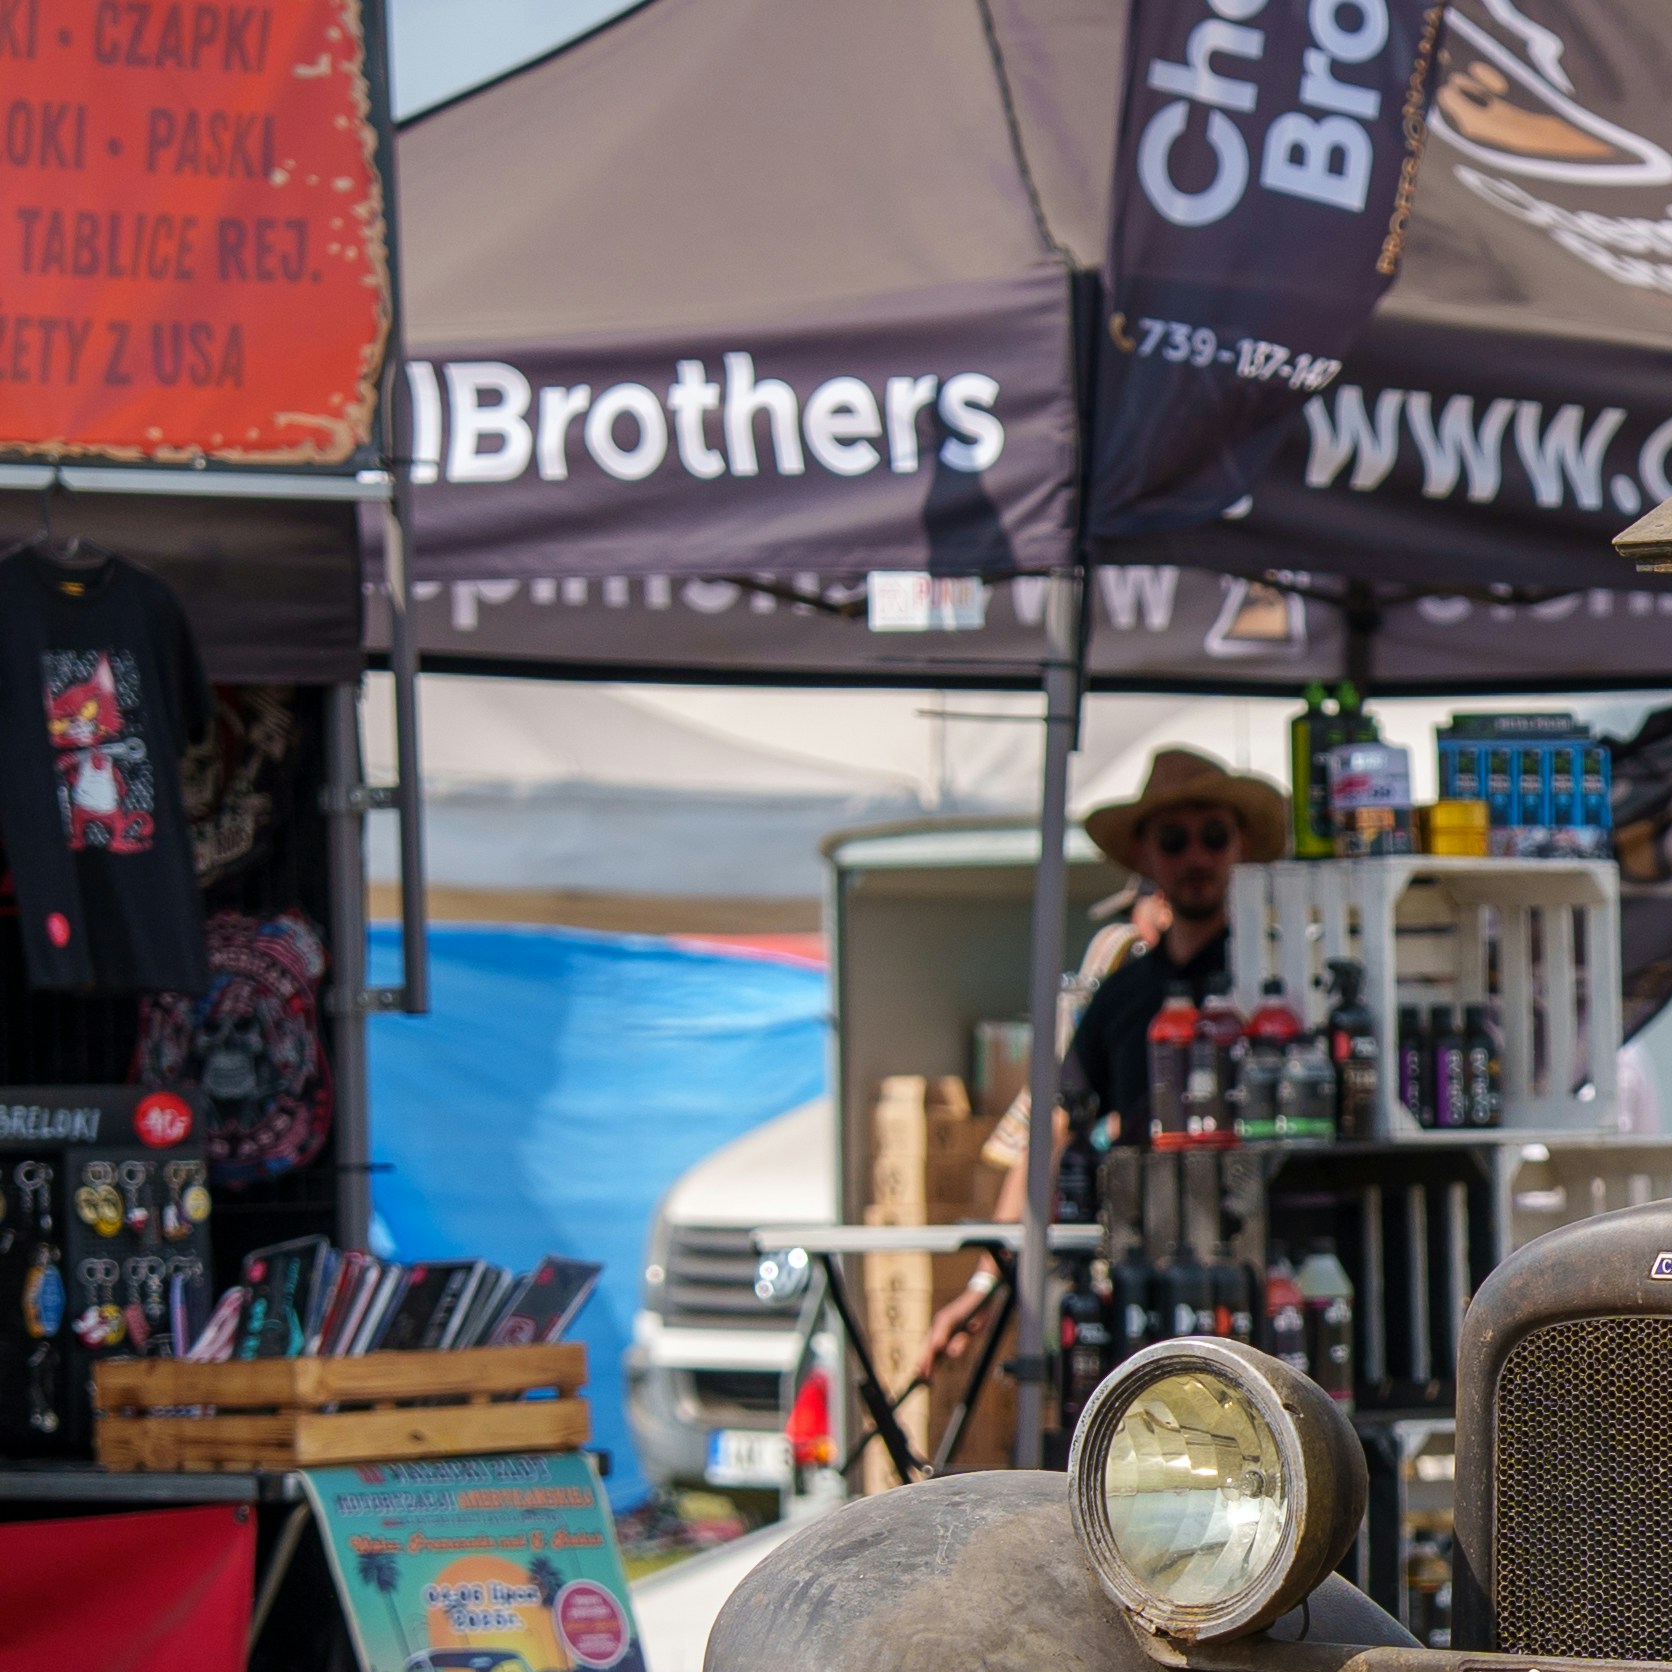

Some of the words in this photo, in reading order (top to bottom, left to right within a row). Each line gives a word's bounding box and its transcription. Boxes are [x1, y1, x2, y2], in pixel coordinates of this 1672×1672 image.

[94, 2, 272, 72] CZAPKI
[146, 107, 275, 181] PASKI
[1137, 0, 1265, 228] Ch
[1260, 0, 1390, 213] Bro
[16, 207, 201, 282] TABLICE
[217, 217, 324, 285] REJ.
[105, 320, 133, 387] Z
[151, 321, 246, 389] USA
